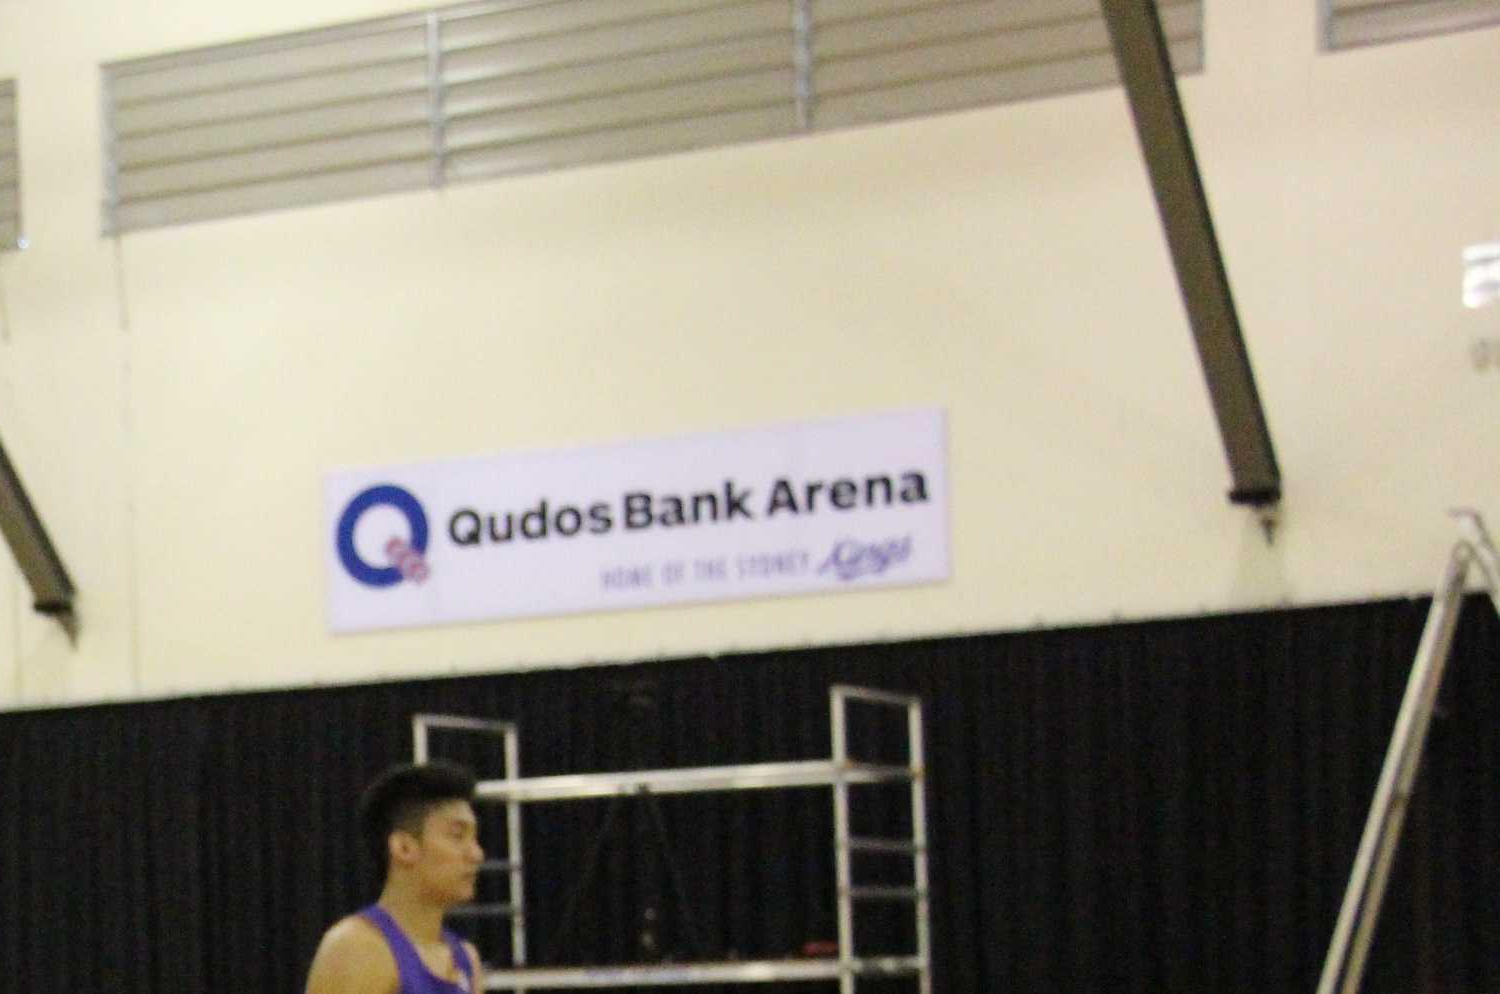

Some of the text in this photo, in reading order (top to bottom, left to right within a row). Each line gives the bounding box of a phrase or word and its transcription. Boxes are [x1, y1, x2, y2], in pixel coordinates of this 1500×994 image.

[448, 469, 929, 547] Qudos Bank Arena
